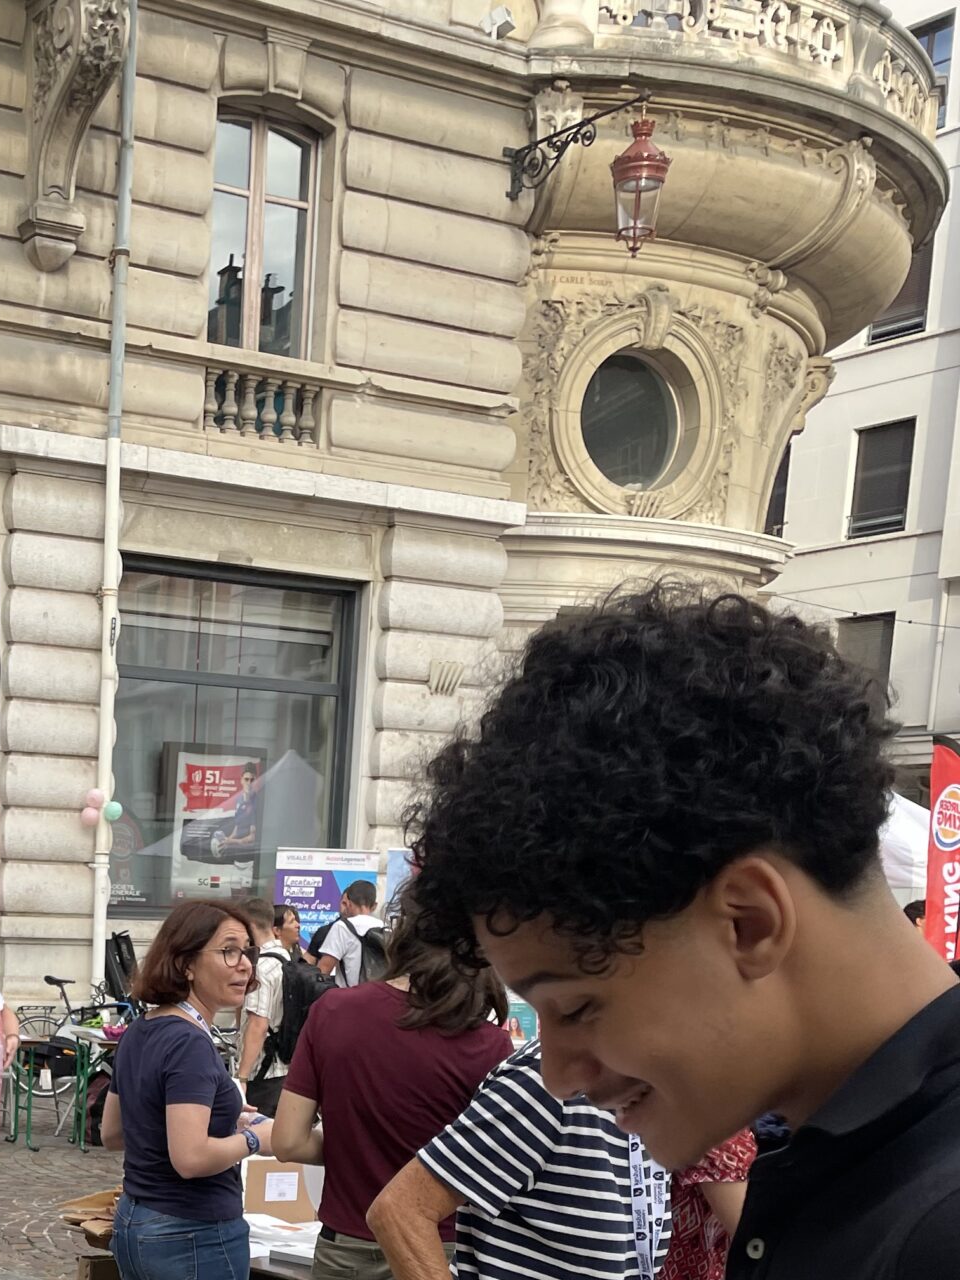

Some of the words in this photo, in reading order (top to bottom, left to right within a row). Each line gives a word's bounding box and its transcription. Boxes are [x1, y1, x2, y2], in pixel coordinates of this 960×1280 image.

[205, 770, 220, 784] 51
[285, 876, 321, 887] Locataire
[285, 887, 313, 897] Bailleur
